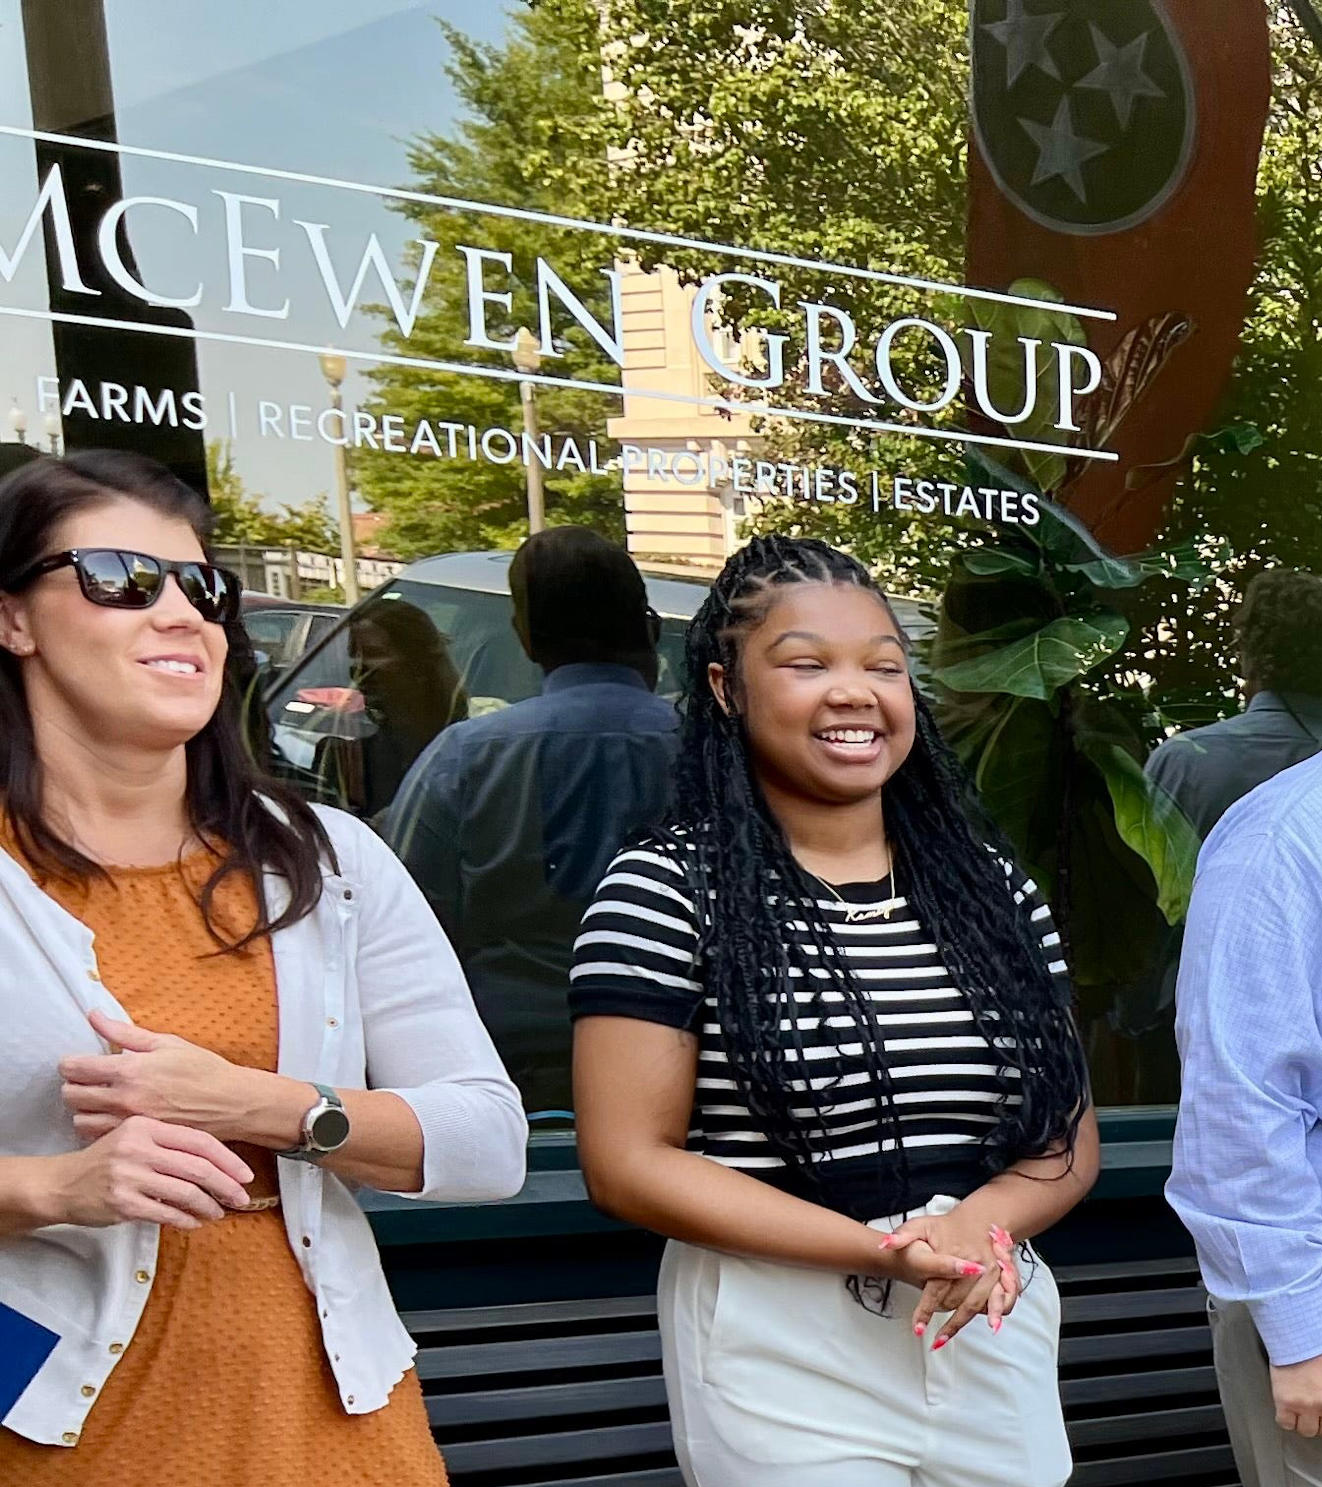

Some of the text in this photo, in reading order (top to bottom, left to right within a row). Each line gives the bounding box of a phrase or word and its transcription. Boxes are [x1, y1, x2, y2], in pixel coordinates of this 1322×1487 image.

[691, 272, 1102, 431] GROUP
[36, 375, 1040, 525] FARMS RECREATIONAL PROPERTIES ESTATES
